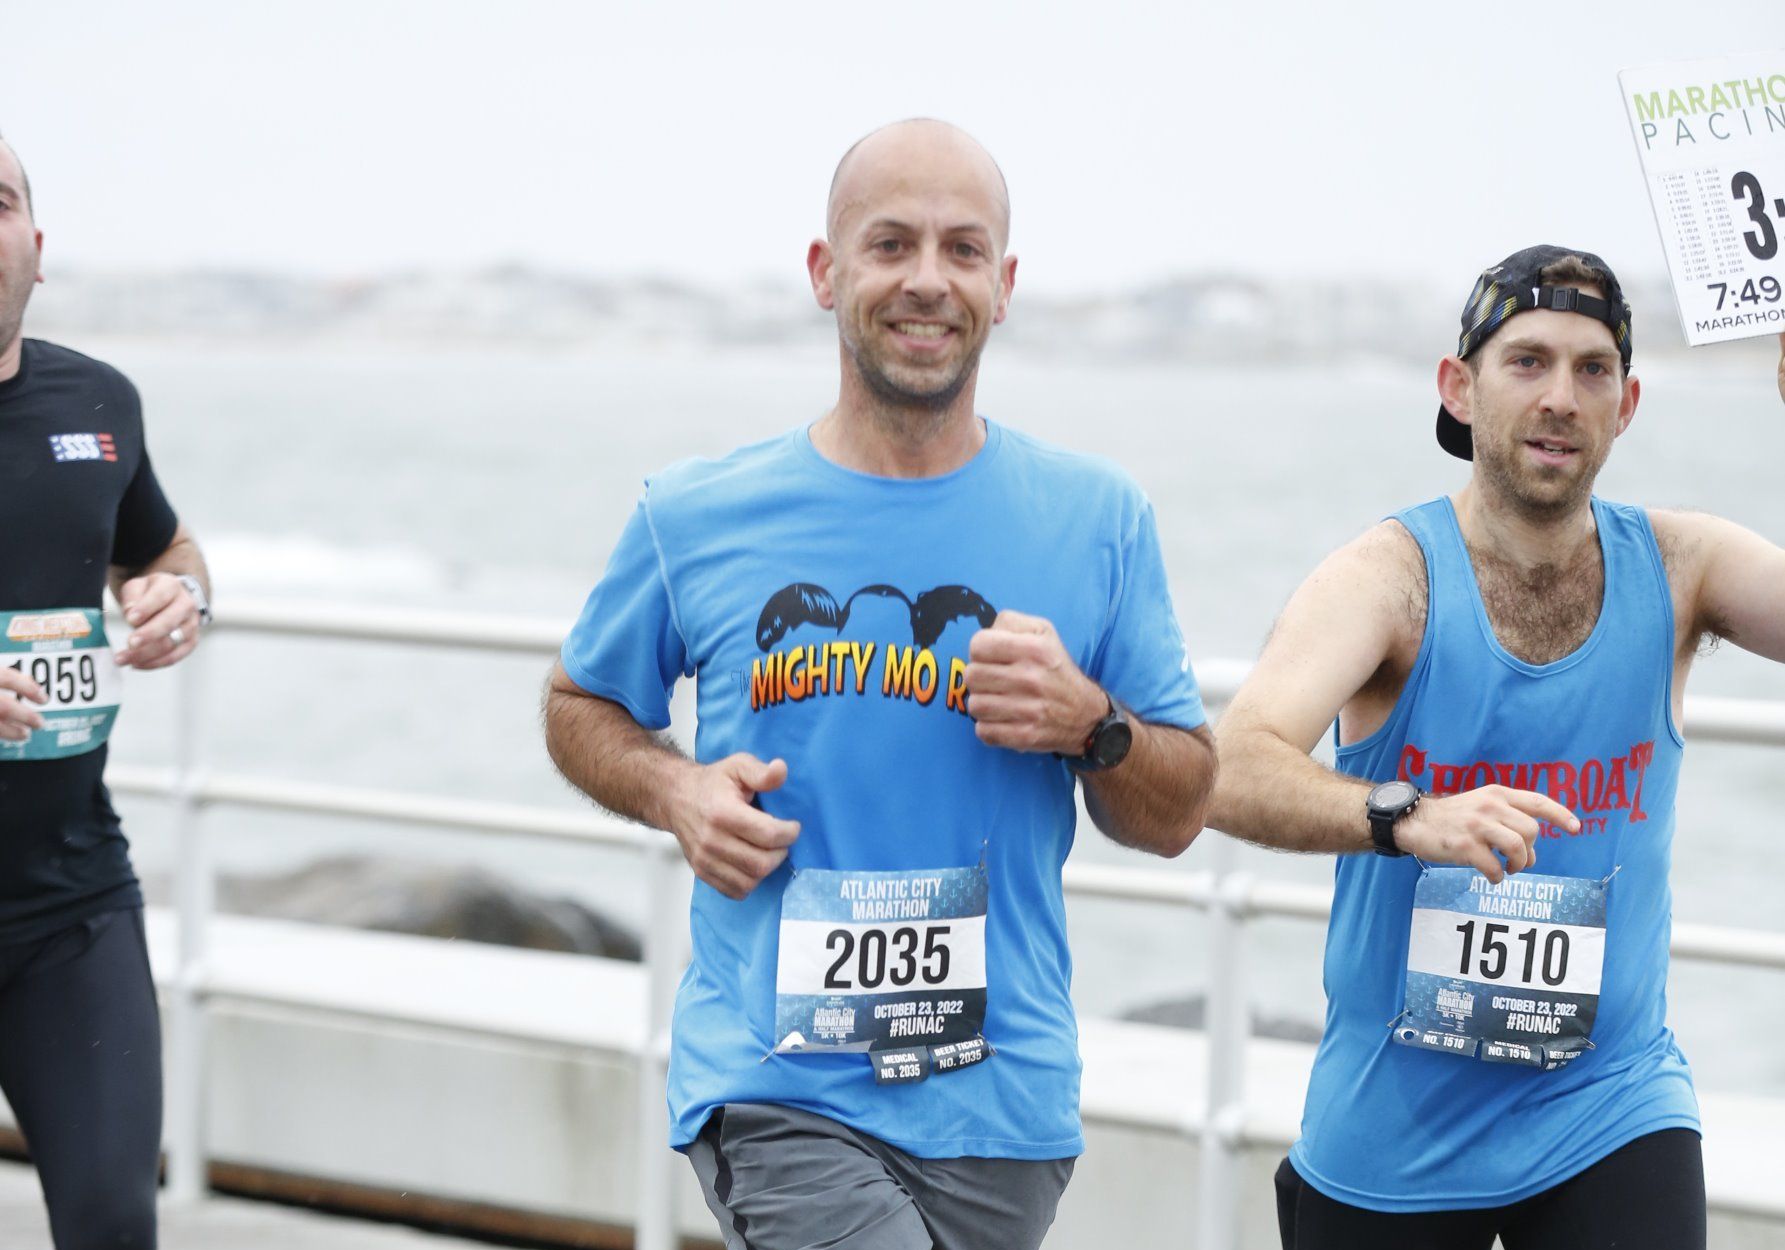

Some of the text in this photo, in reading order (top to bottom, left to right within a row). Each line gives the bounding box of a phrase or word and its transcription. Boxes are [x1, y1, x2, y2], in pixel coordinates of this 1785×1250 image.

[1633, 75, 1785, 121] MARATHO
[1641, 104, 1785, 150] PACIN
[1707, 276, 1781, 311] 7:49
[751, 641, 874, 712] MIGHTY
[883, 644, 939, 706] MO
[1568, 817, 1608, 838] ITY
[840, 878, 942, 900] ATLANTIC CITY
[1470, 876, 1565, 902] ATLANTIC CITY
[852, 899, 929, 920] MARATHON
[1478, 898, 1552, 920] MARATHON
[824, 926, 951, 989] 2035
[1456, 919, 1570, 986] 1510
[874, 1000, 964, 1019] OCTOBER 23, 2022
[1492, 996, 1578, 1018] OCTOBER 23, 2022
[889, 1016, 945, 1037] #RUNAC
[1506, 1012, 1561, 1034] #RUNAC
[934, 1039, 984, 1057] BEER TICKET
[1423, 1034, 1439, 1046] NO.
[1443, 1036, 1465, 1049] 1510
[882, 1053, 919, 1064] MEDICAL
[939, 1049, 982, 1069] NO. 2035
[1488, 1046, 1531, 1060] NO. 1510
[881, 1064, 921, 1079] NO. 2035
